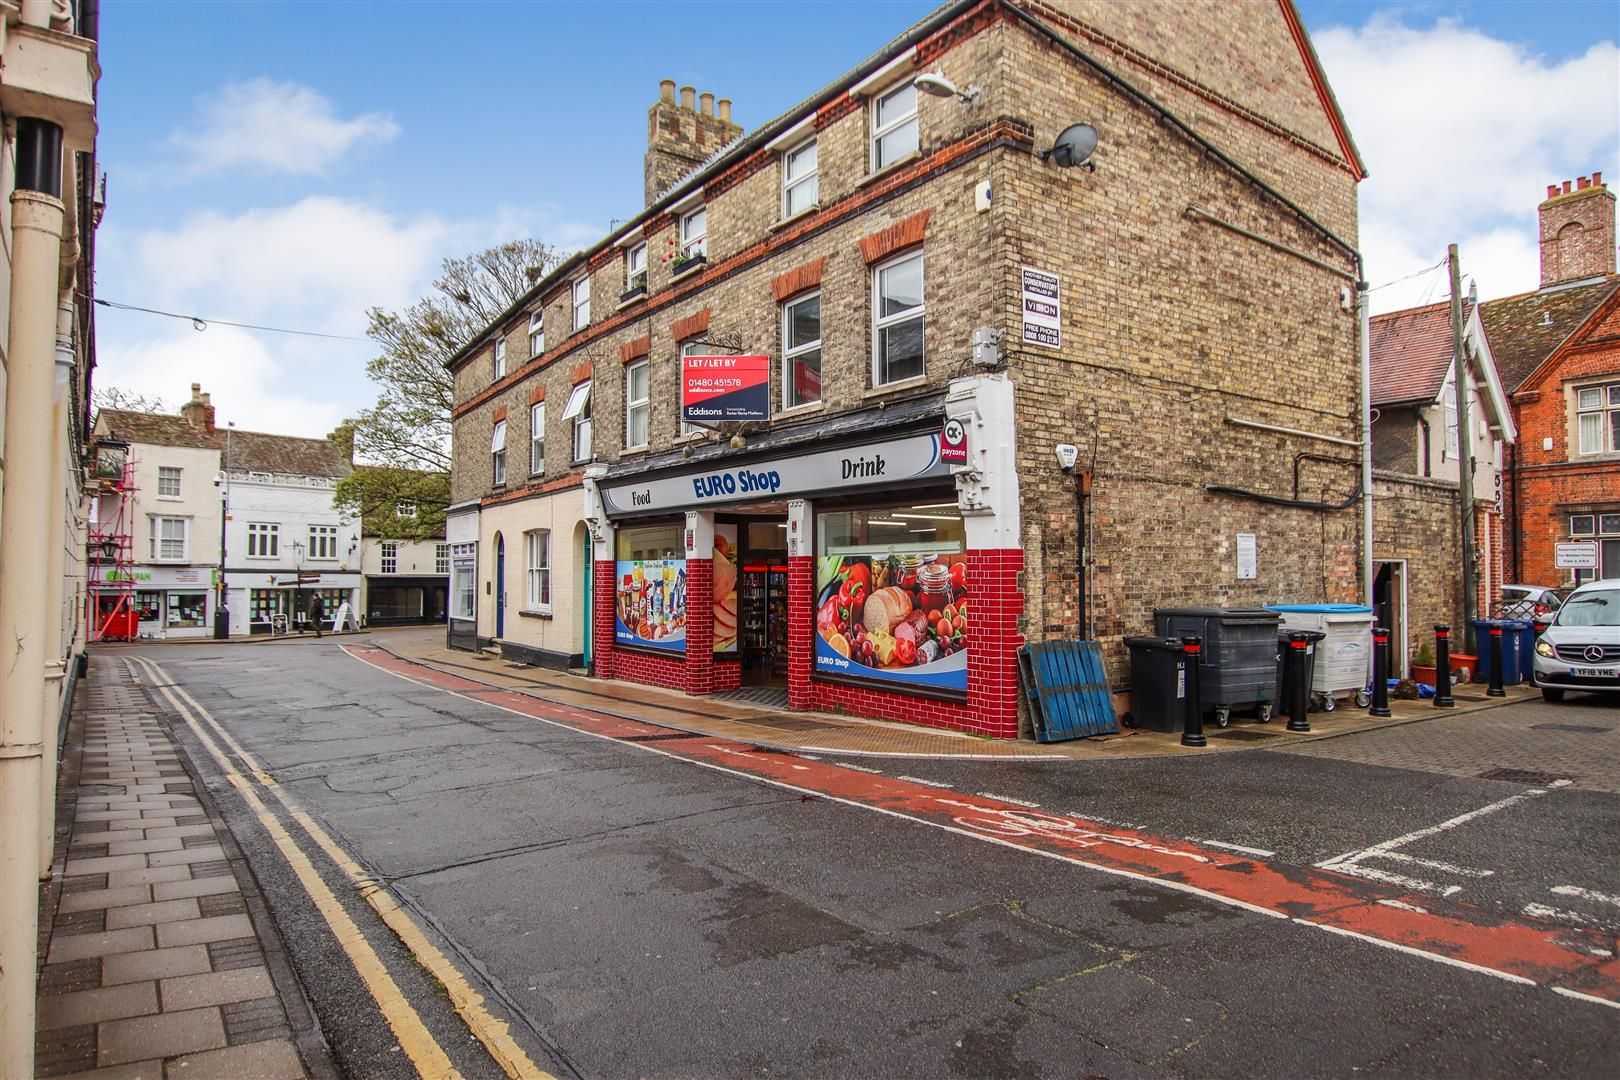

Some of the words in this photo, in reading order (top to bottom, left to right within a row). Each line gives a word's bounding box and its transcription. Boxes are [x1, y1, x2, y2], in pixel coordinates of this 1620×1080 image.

[1024, 277, 1057, 292] CONSERVATORY
[1027, 301, 1056, 315] VISION
[1026, 324, 1039, 332] FREE
[1040, 327, 1058, 336] PHONE
[709, 359, 723, 367] LET
[724, 358, 736, 367] BY
[688, 378, 712, 386] 01480
[714, 378, 741, 386] 451578
[688, 407, 722, 416] Eddisons
[942, 448, 965, 456] payzone
[842, 455, 886, 479] Drink
[693, 473, 736, 498] EURO
[738, 470, 781, 492] Shop
[632, 490, 650, 506] Food
[818, 656, 833, 665] EURO
[835, 658, 849, 668] Shop
[1577, 668, 1595, 676] YF18
